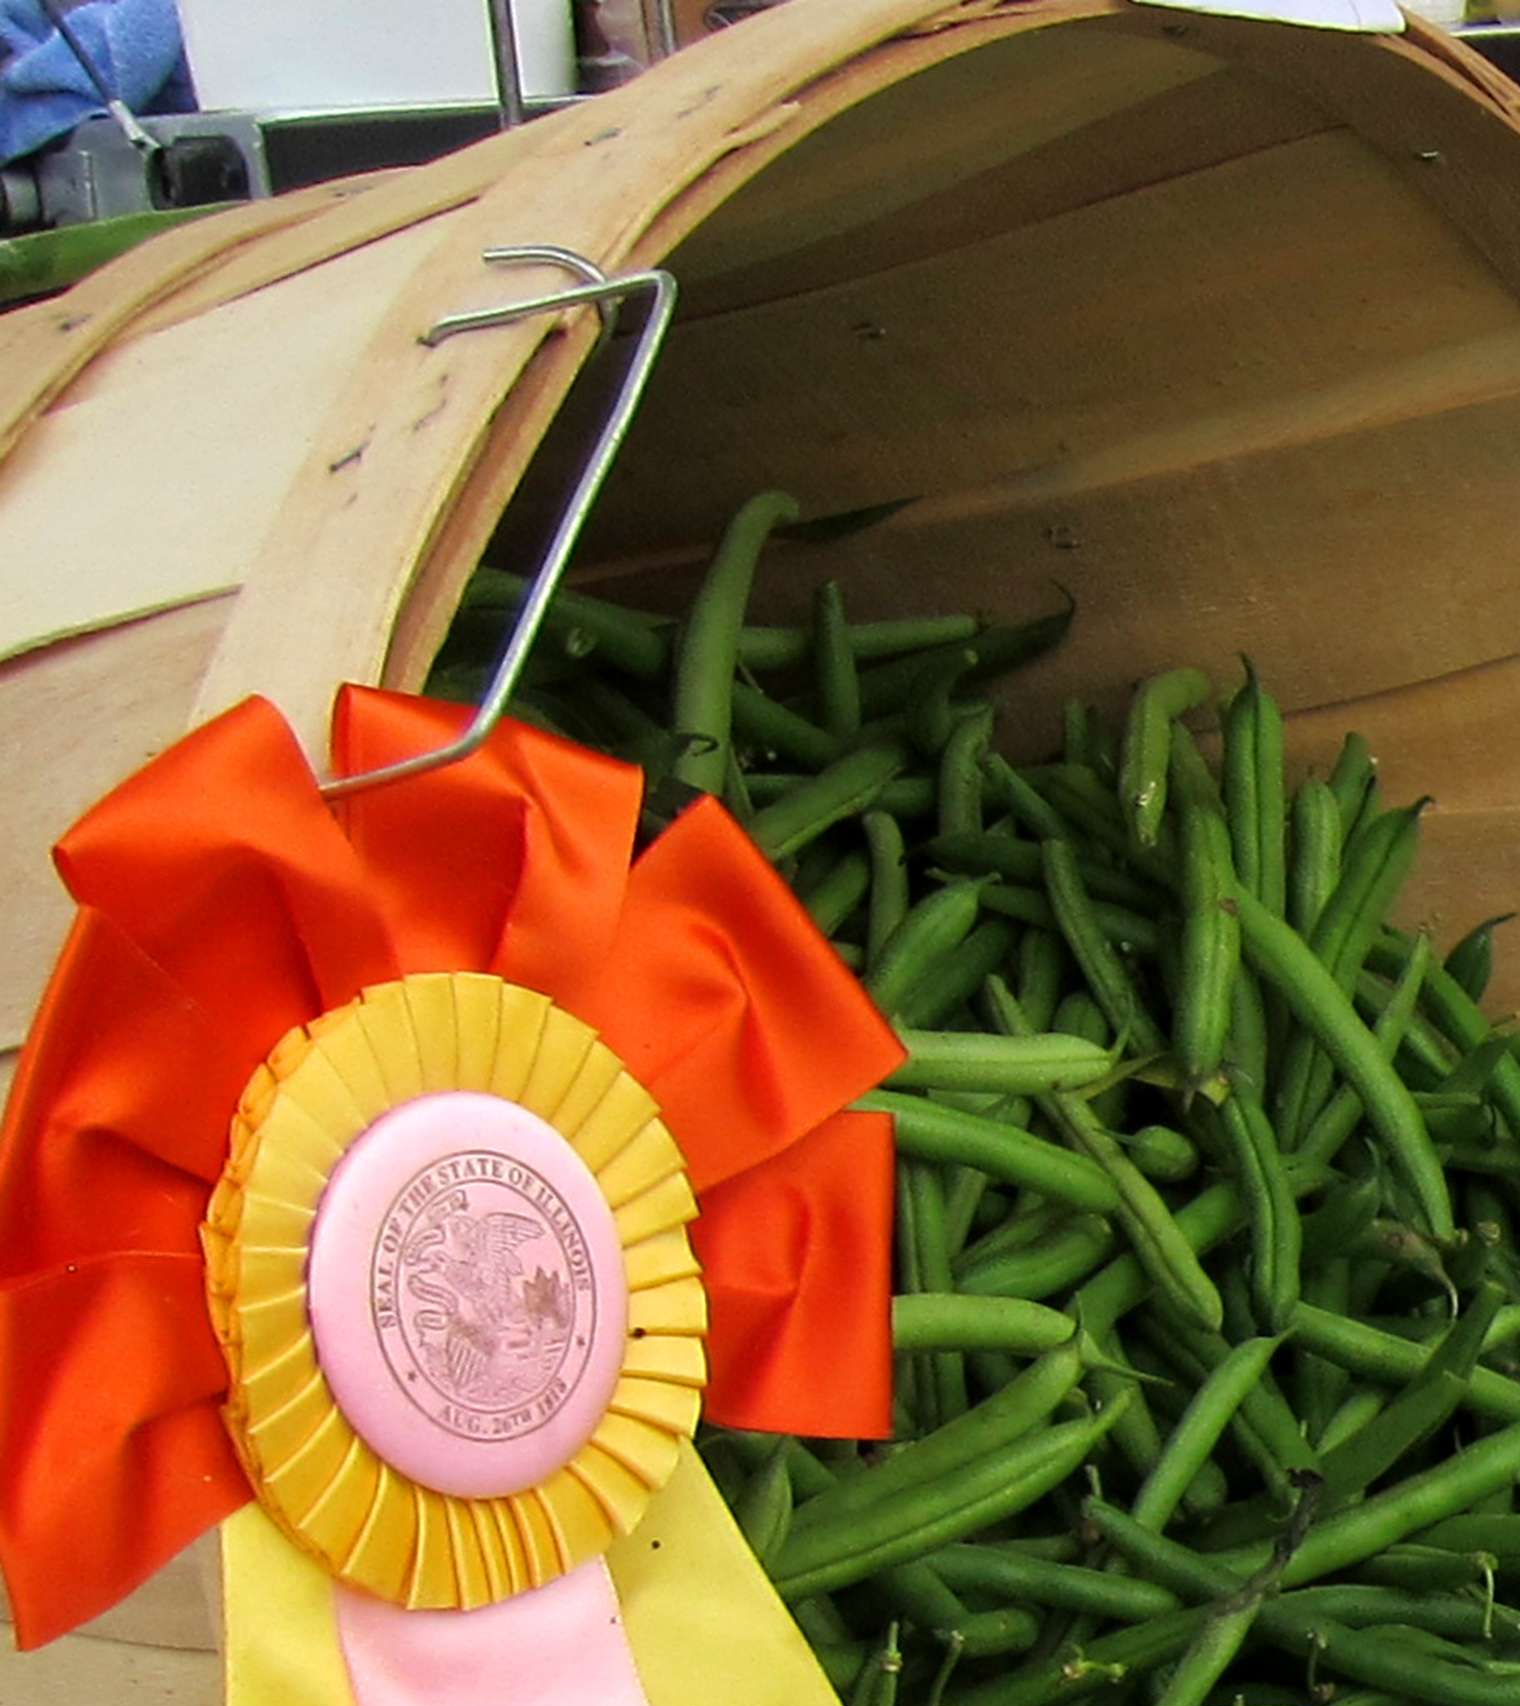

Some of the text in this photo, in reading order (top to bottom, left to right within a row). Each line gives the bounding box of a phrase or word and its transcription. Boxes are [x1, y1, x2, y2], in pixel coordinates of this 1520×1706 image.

[377, 1158, 592, 1329] SEAL OF THE STATE OF ILLINOIS
[440, 1404, 489, 1435] AUG.
